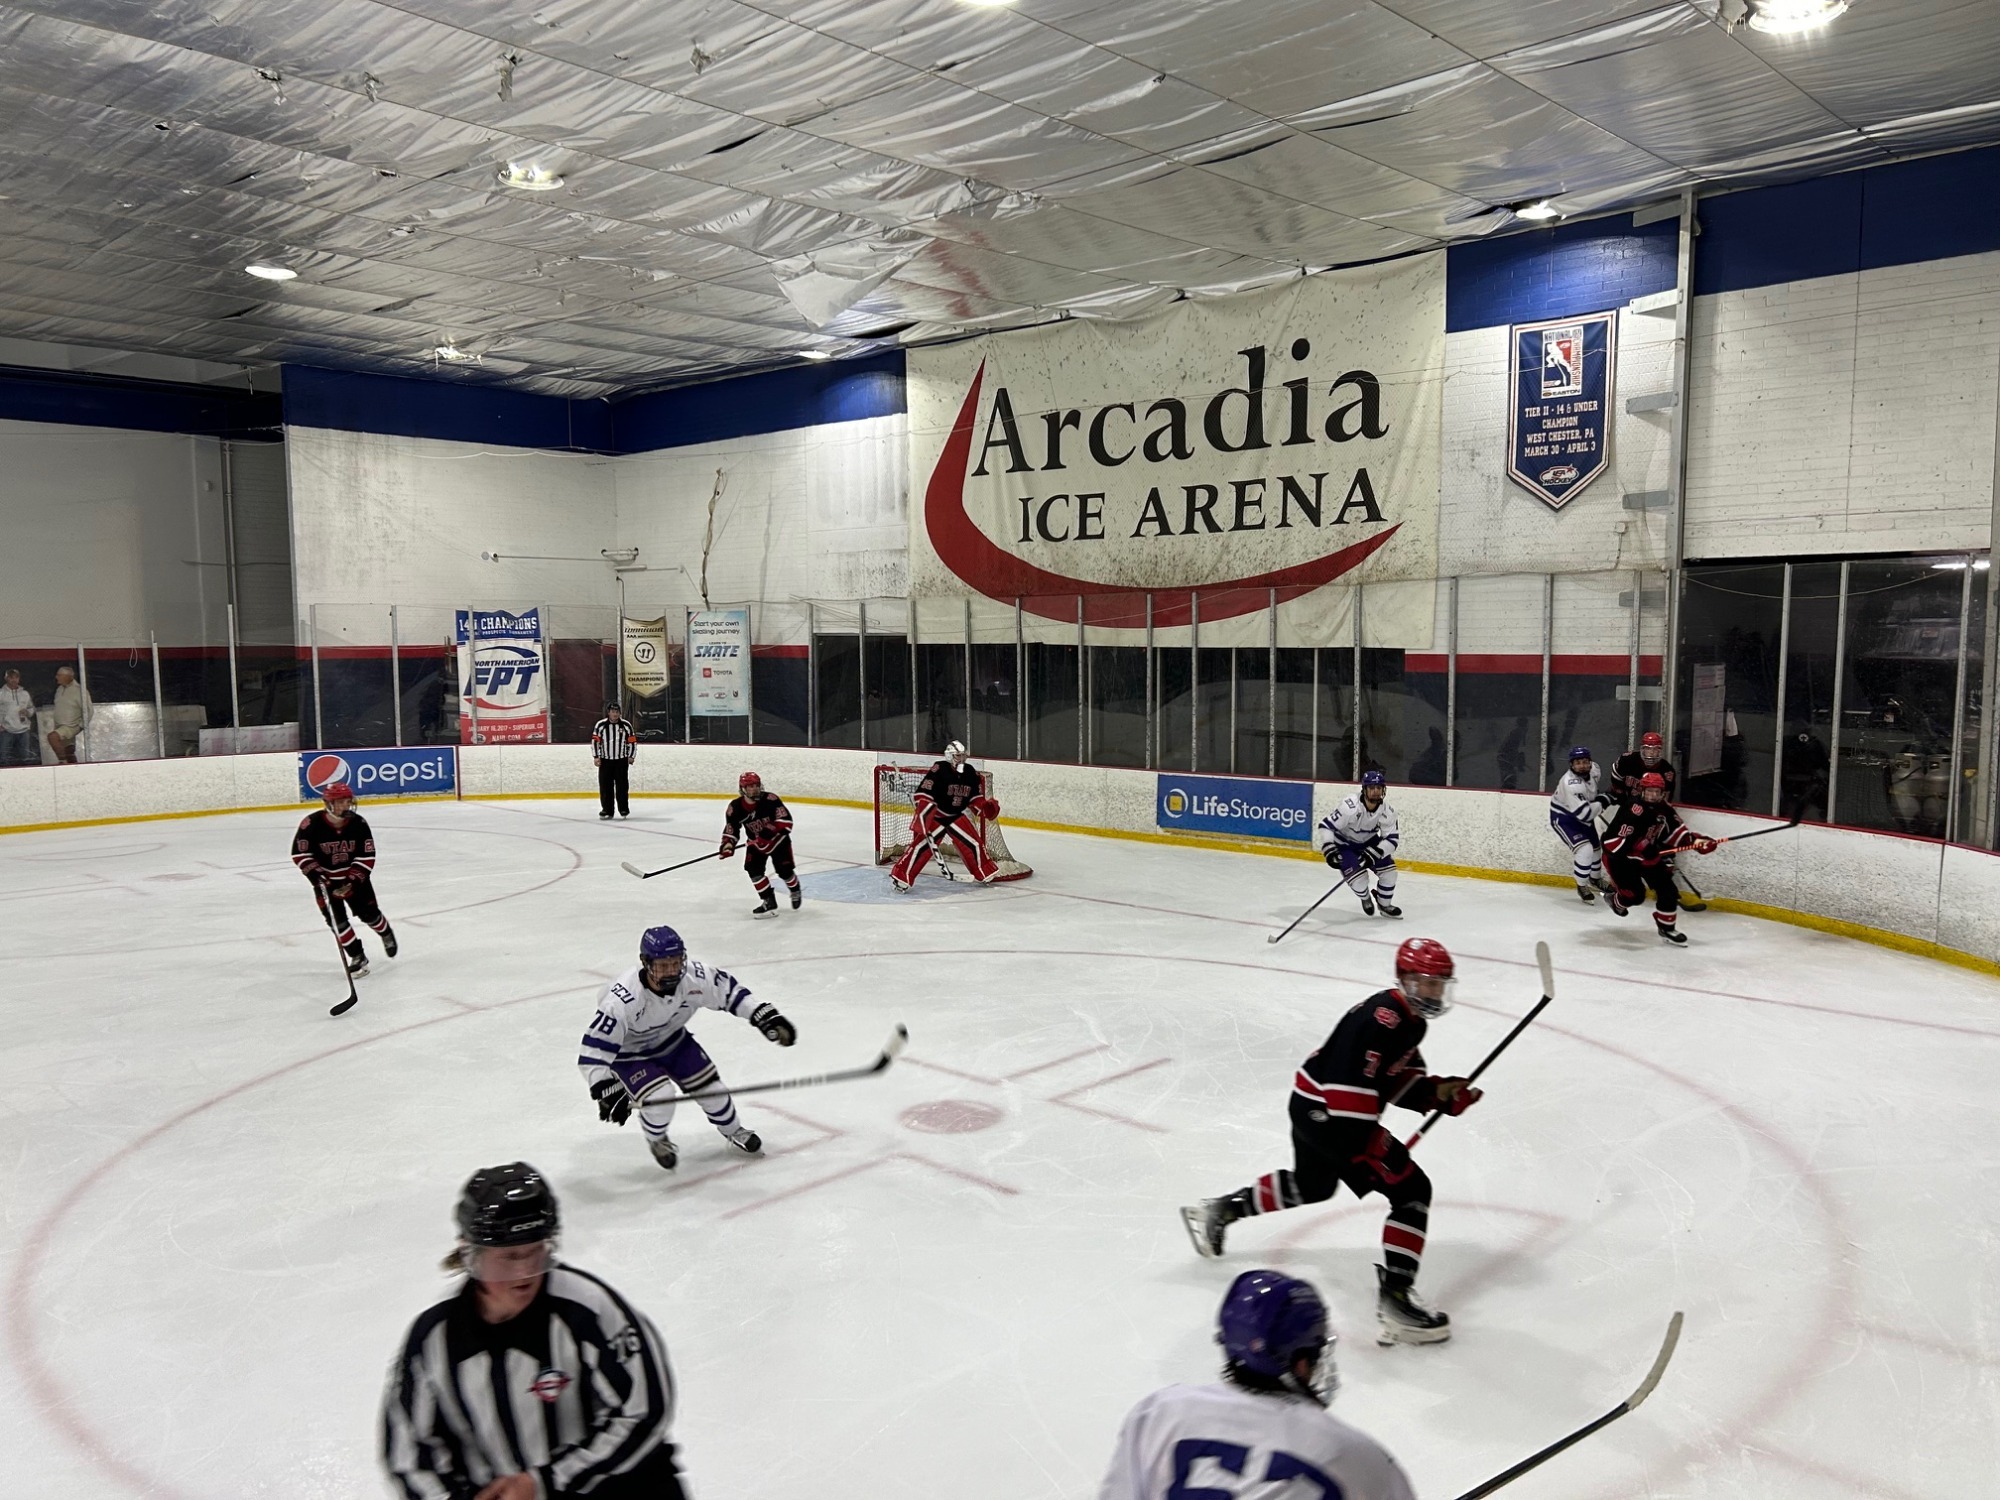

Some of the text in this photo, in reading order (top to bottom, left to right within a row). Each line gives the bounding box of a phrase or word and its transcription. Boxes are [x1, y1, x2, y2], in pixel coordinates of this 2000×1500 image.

[971, 338, 1390, 477] Arcadia
[1525, 407, 1541, 418] TIER
[1543, 405, 1549, 416] II
[1556, 404, 1564, 415] 14
[1574, 400, 1598, 413] UNDER
[1542, 416, 1578, 429] CHAMPION
[1526, 428, 1594, 444] WEST CHESTER, PA
[1524, 445, 1549, 457] MARCH
[1551, 444, 1559, 455] 30
[1567, 442, 1588, 454] APRIL
[1591, 441, 1596, 451] 3
[1543, 478, 1571, 486] HOCKEY
[1018, 467, 1388, 543] ICE ARENA
[481, 616, 538, 630] CHAMPIONS
[694, 645, 740, 657] SKATE
[501, 658, 540, 667] AMERICAN
[357, 756, 443, 788] pepsi
[610, 982, 635, 1005] GCU
[589, 1009, 617, 1036] 78
[629, 1068, 647, 1085] GCU
